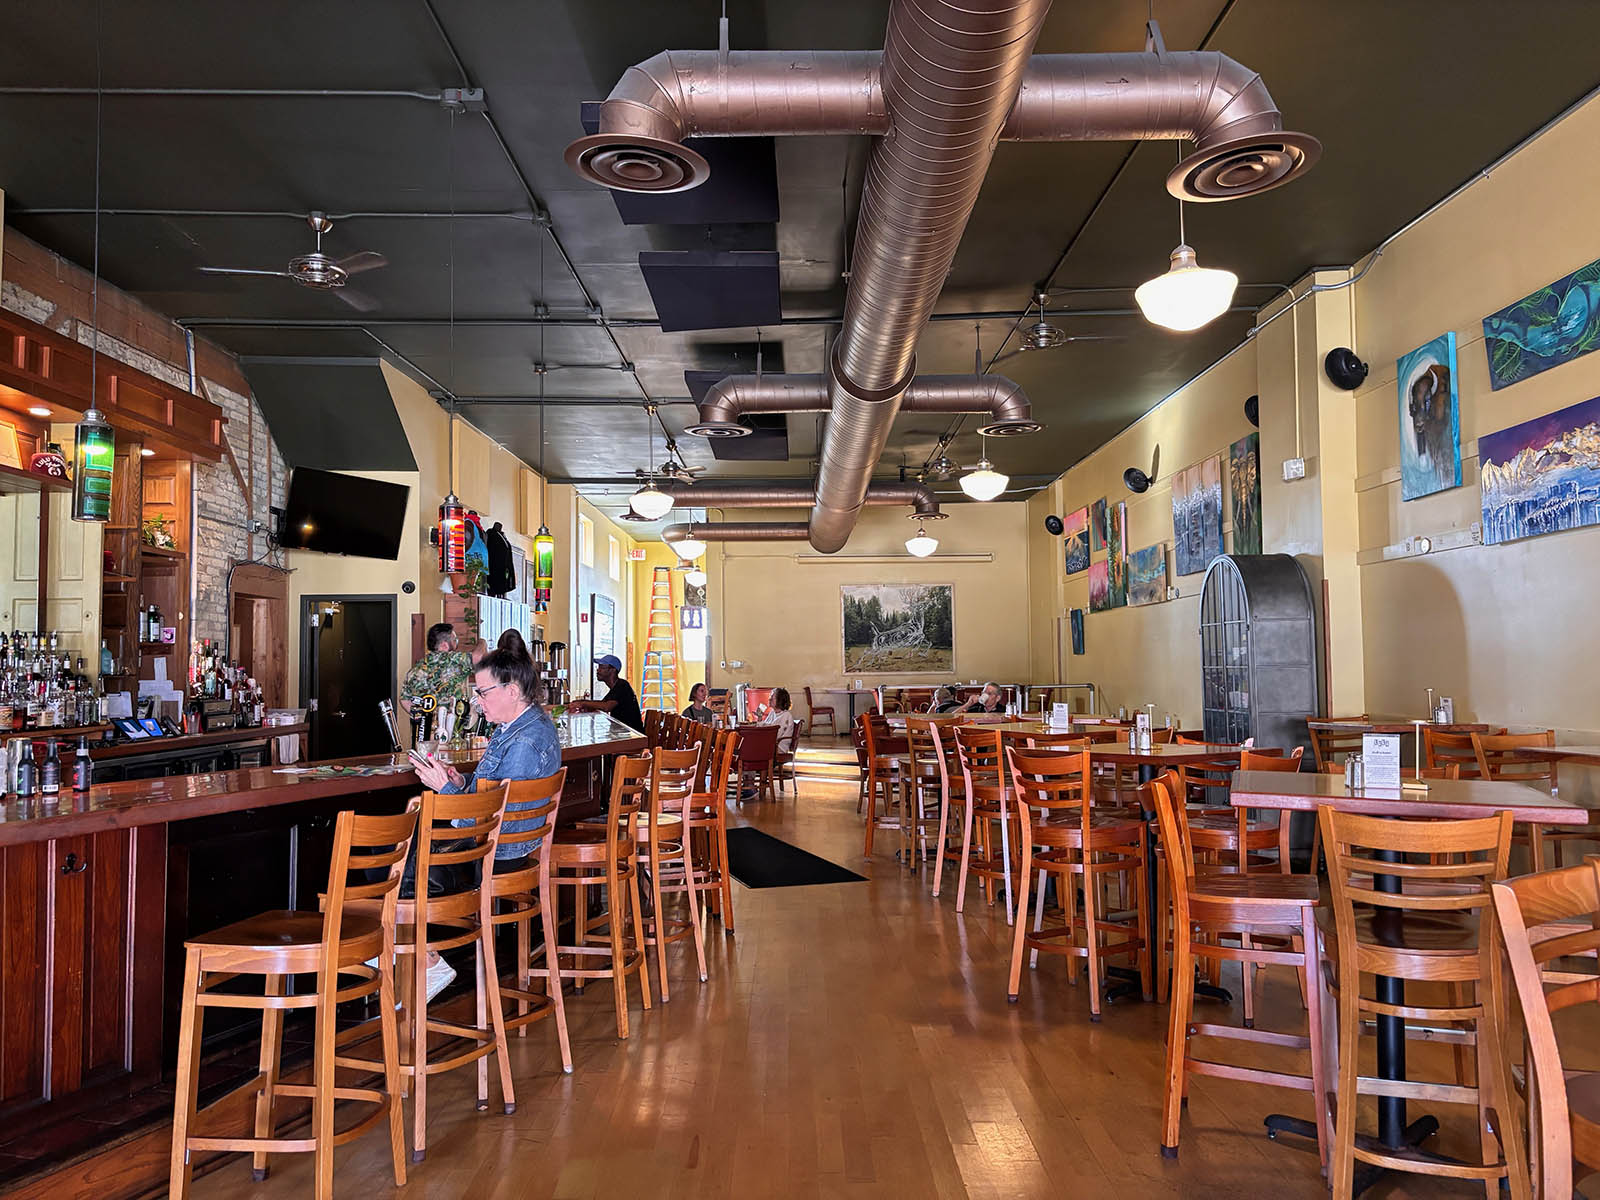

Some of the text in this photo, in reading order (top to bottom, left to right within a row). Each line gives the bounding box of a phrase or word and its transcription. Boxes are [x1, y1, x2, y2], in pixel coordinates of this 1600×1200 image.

[35, 457, 50, 468] LULU
[632, 549, 643, 558] EXIT
[424, 698, 433, 708] H
